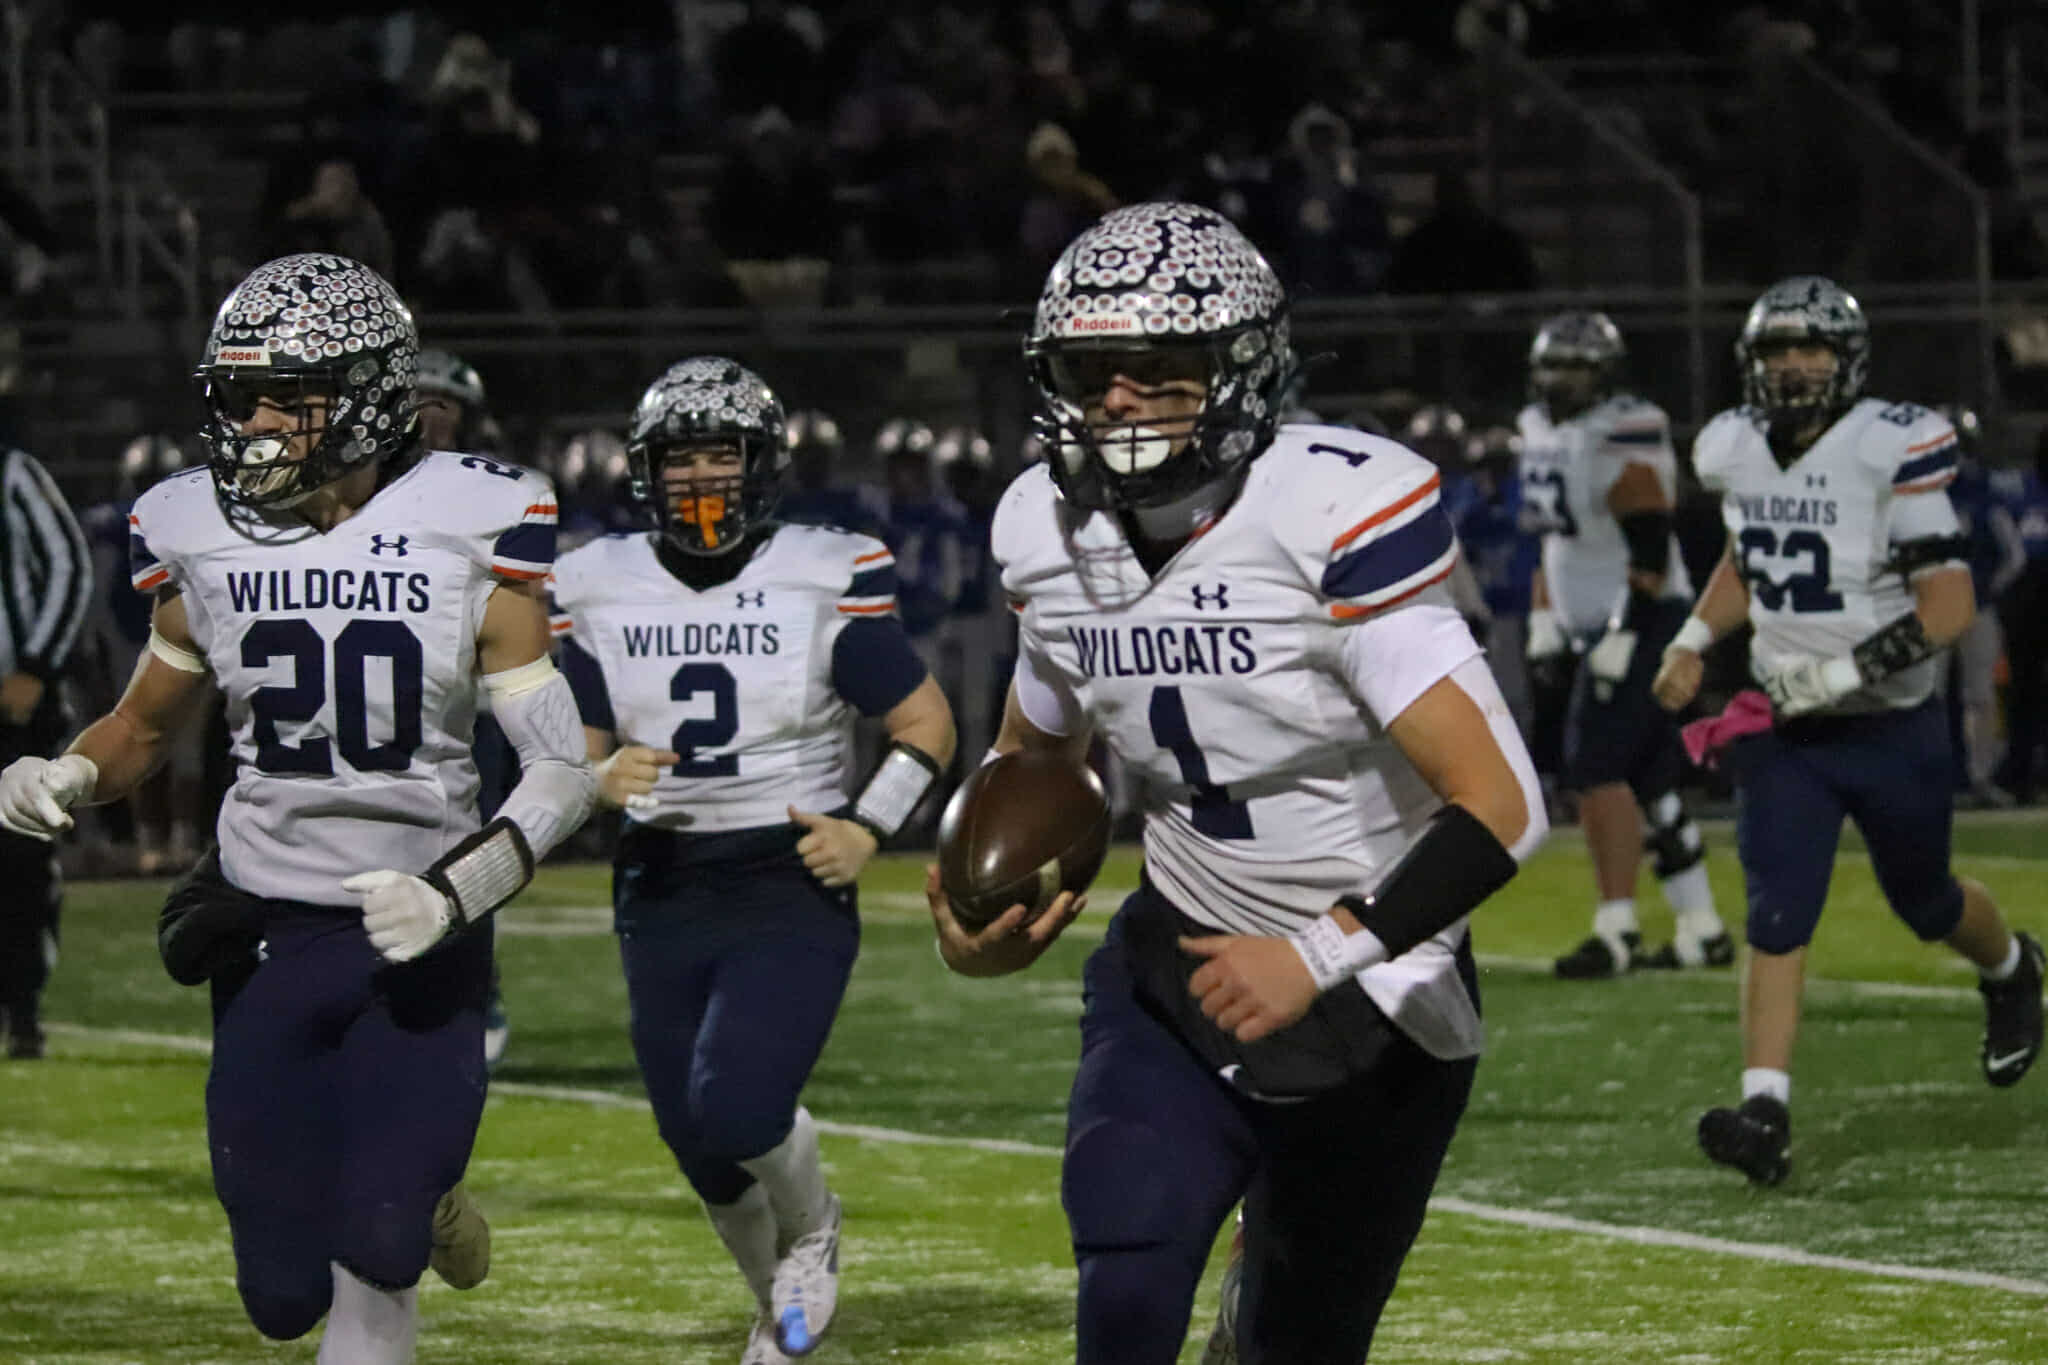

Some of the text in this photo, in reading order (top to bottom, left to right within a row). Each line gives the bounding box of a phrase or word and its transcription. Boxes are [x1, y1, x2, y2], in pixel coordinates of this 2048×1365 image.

[1073, 317, 1131, 331] Riddell
[1307, 442, 1372, 467] 1
[227, 568, 430, 613] WILDCATS
[623, 622, 779, 657] WILDCATS
[1067, 625, 1257, 678] WILDCATS
[240, 618, 424, 777] 20
[670, 662, 740, 777] 2
[1147, 685, 1255, 840] 1
